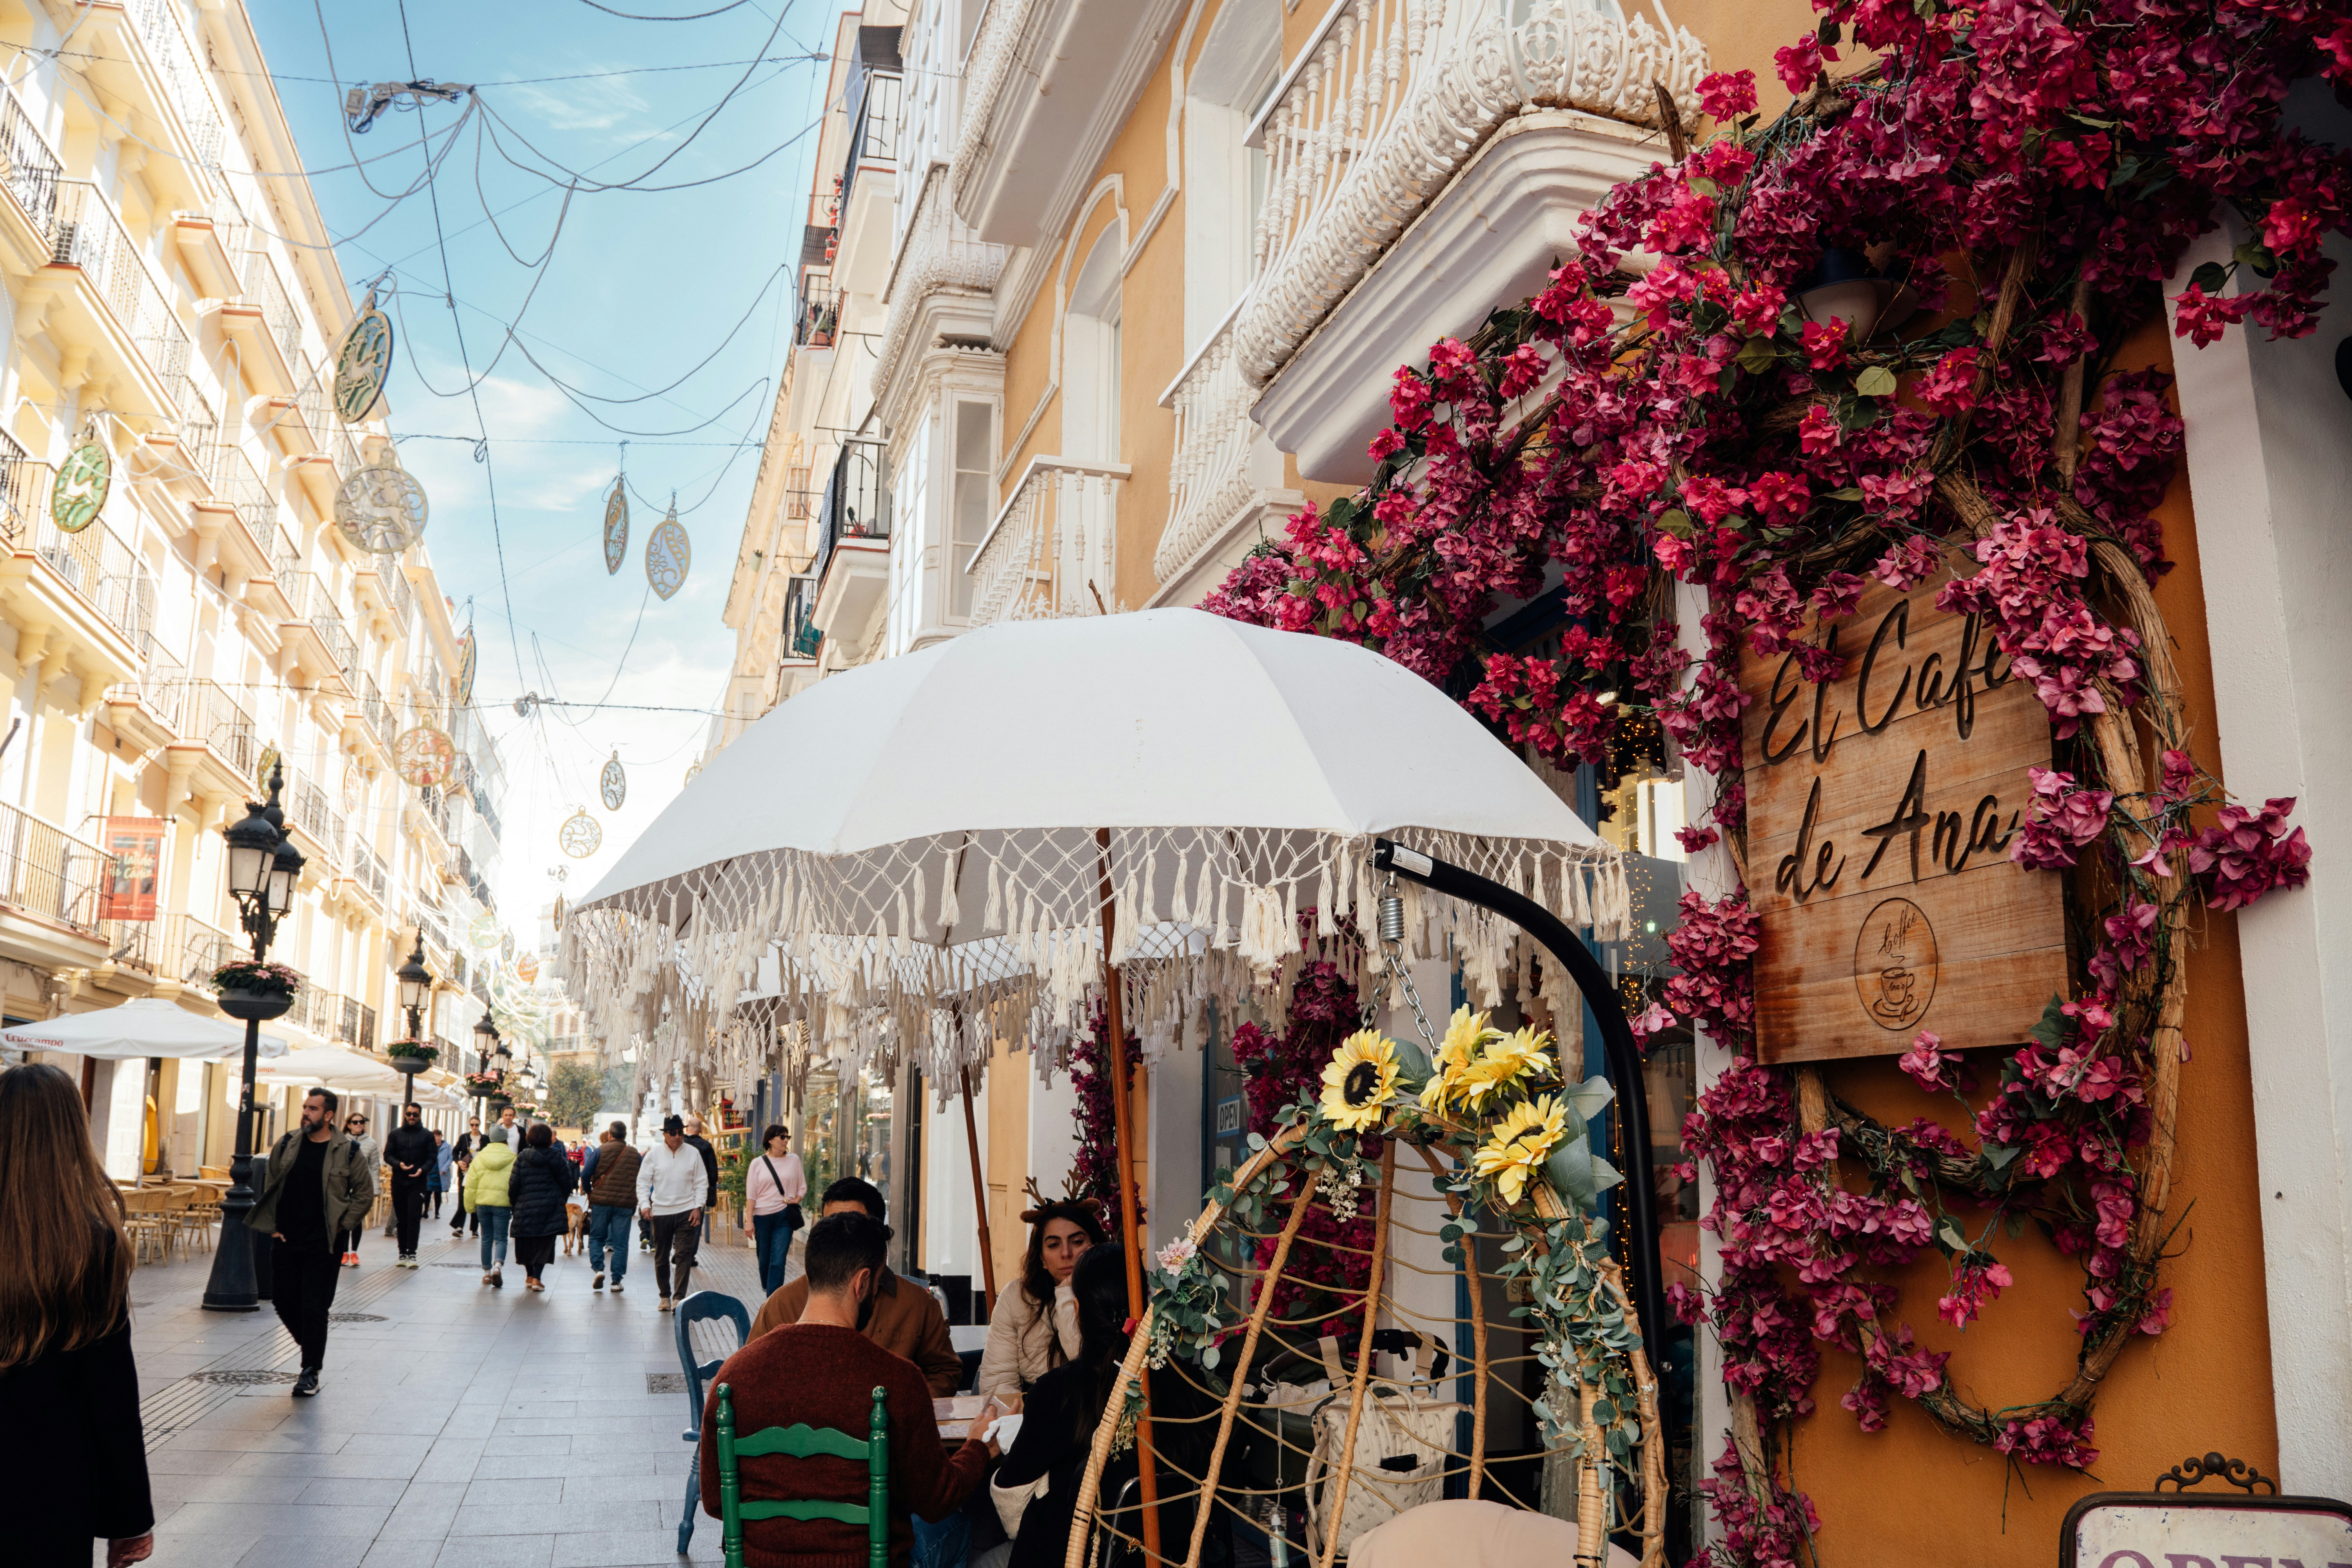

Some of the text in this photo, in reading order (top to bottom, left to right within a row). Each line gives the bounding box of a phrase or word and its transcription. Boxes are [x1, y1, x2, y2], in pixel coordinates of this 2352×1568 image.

[1761, 624, 1841, 766] El
[1775, 749, 2019, 904] de Ana
[1877, 904, 1917, 955] Coffee
[1885, 981, 1906, 992] Ana's
[5, 1033, 64, 1047] Cruzcampo
[1220, 1102, 1238, 1131] OPEN
